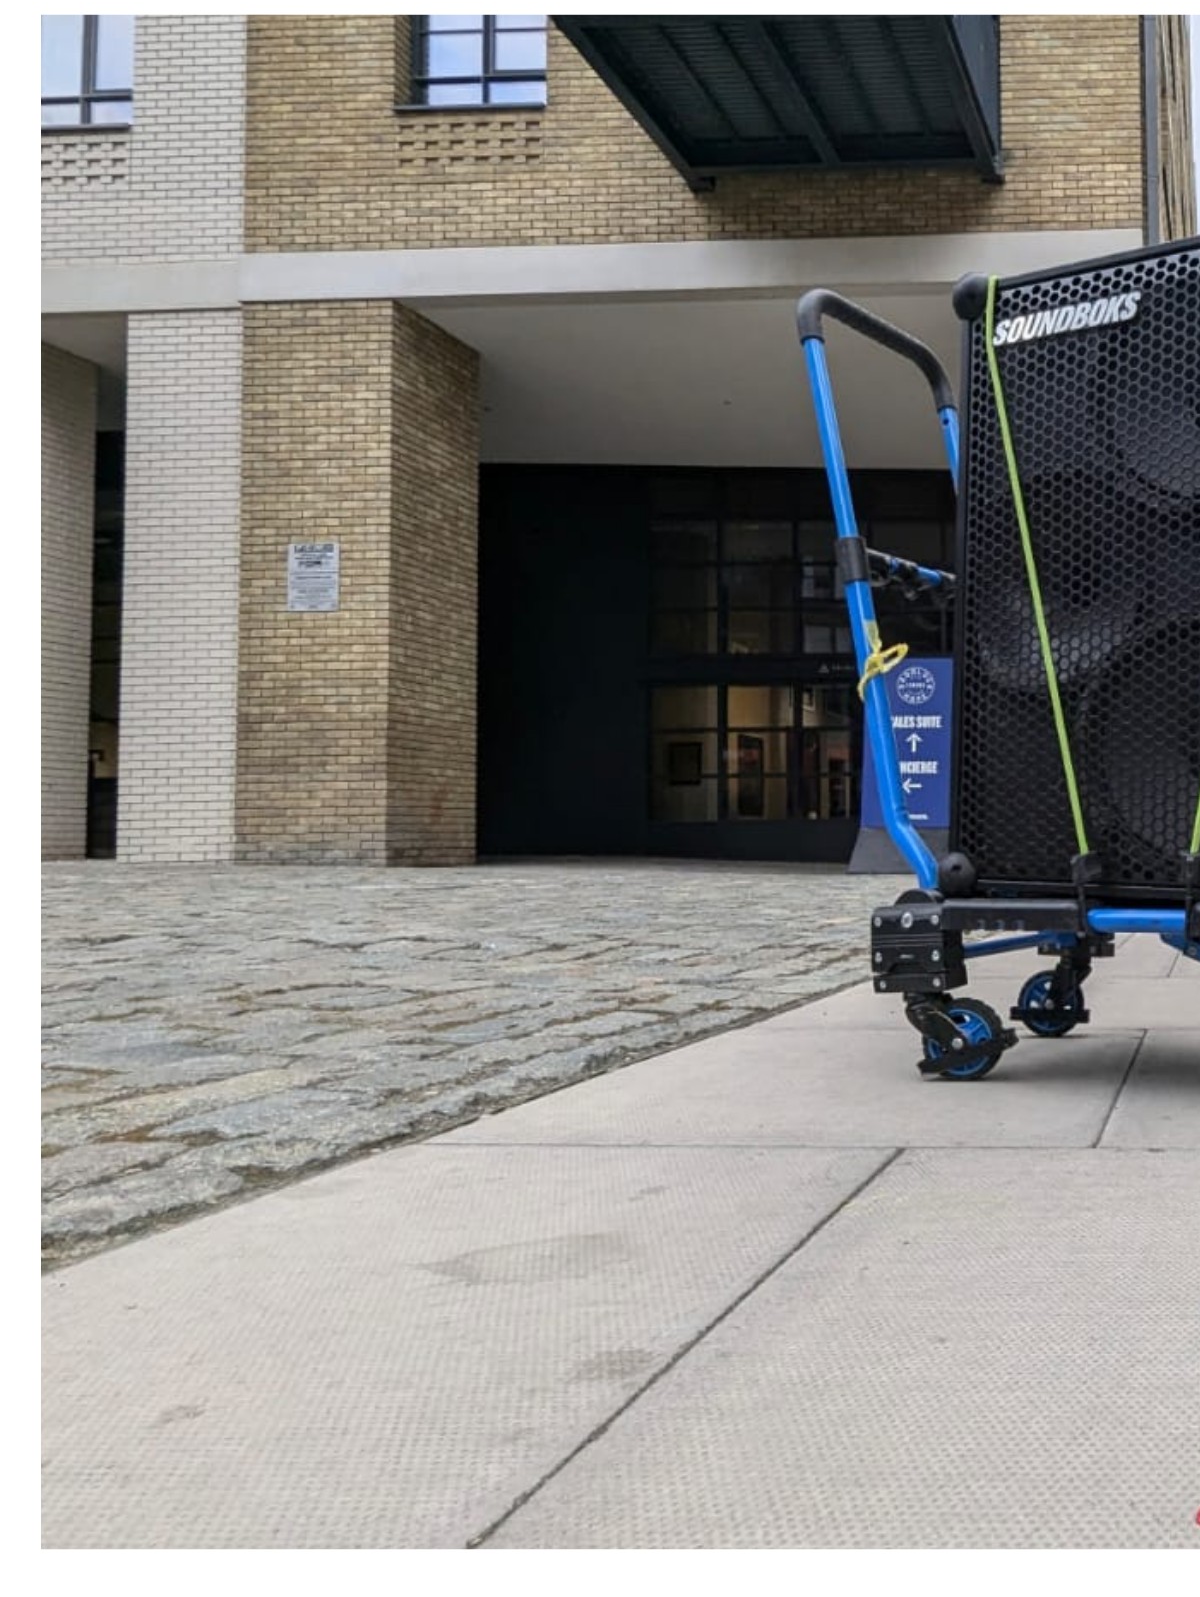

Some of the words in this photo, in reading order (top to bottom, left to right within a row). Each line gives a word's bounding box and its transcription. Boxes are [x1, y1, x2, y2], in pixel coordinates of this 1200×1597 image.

[992, 290, 1142, 347] SOUNDBOKS
[916, 714, 943, 729] SUITE
[899, 760, 938, 774] NCIERGE
